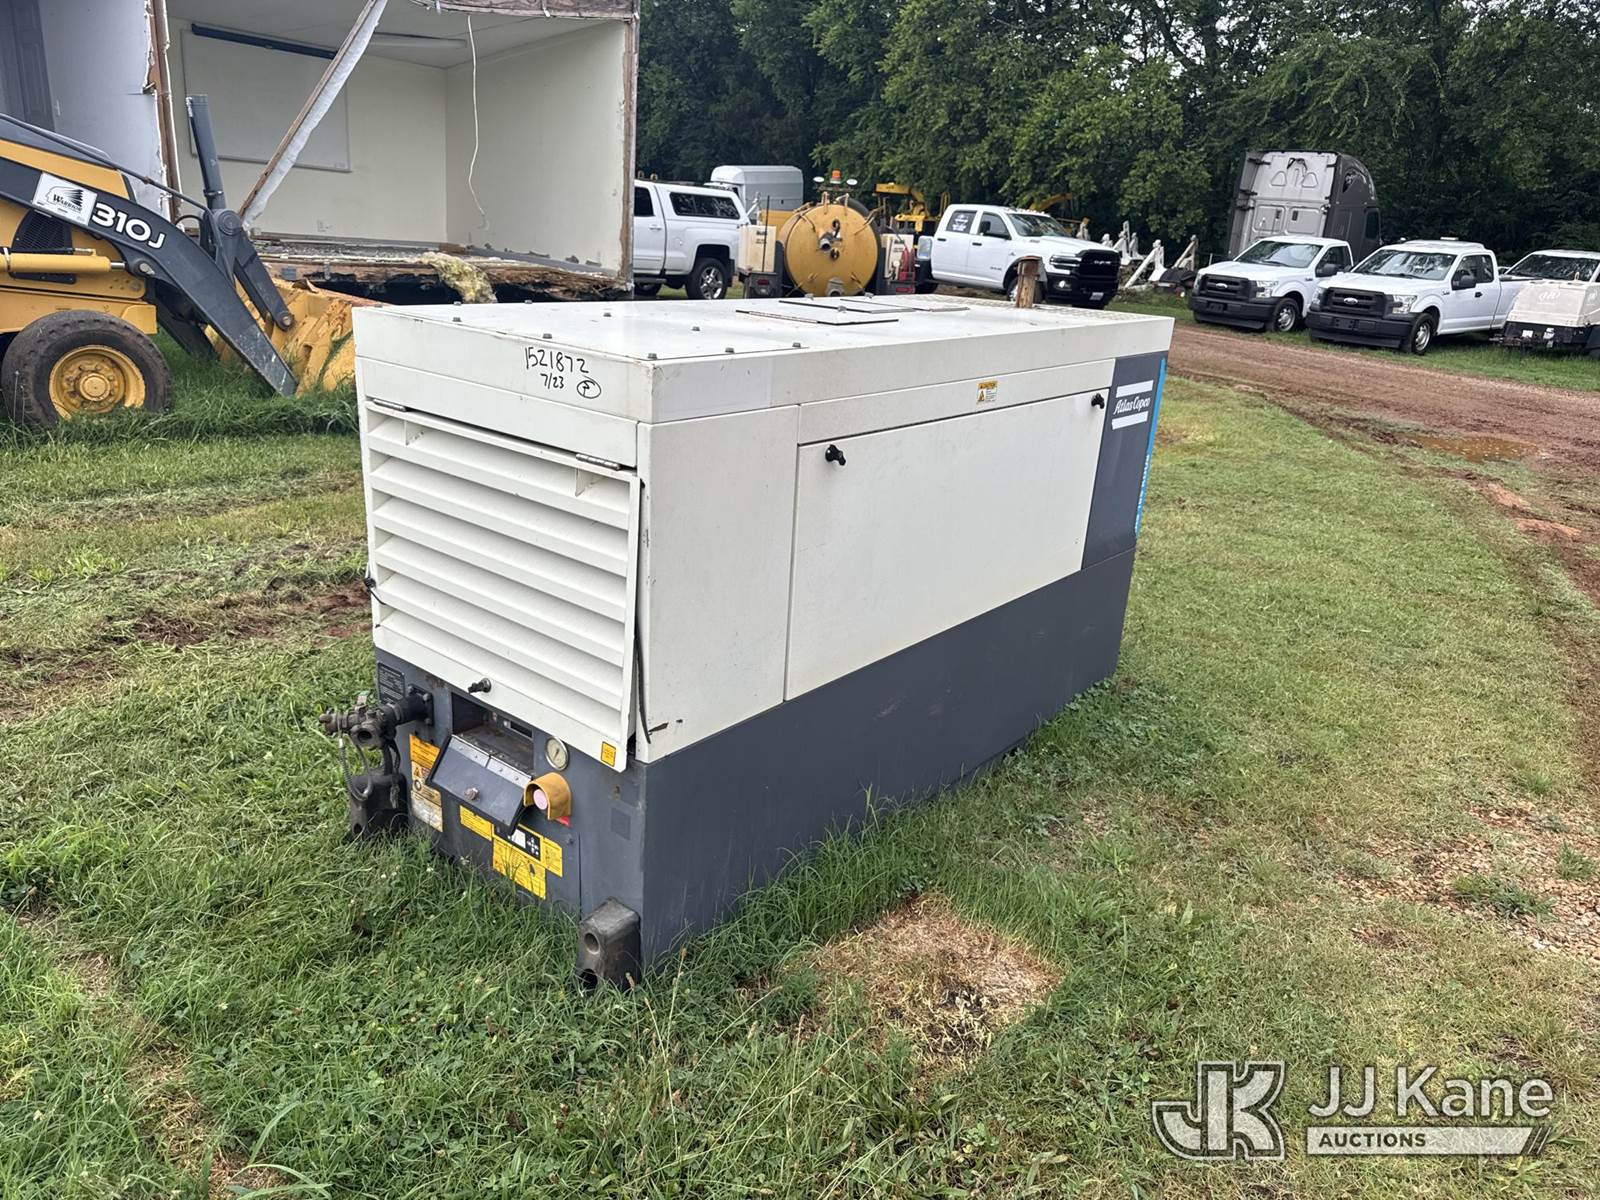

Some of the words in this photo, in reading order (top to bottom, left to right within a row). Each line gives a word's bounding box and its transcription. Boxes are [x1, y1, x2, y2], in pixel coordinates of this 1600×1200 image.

[91, 202, 166, 249] 310J
[525, 346, 589, 374] 1521872
[540, 373, 565, 389] 7/23
[1113, 398, 1133, 415] Atlas
[1133, 396, 1151, 412] Copco
